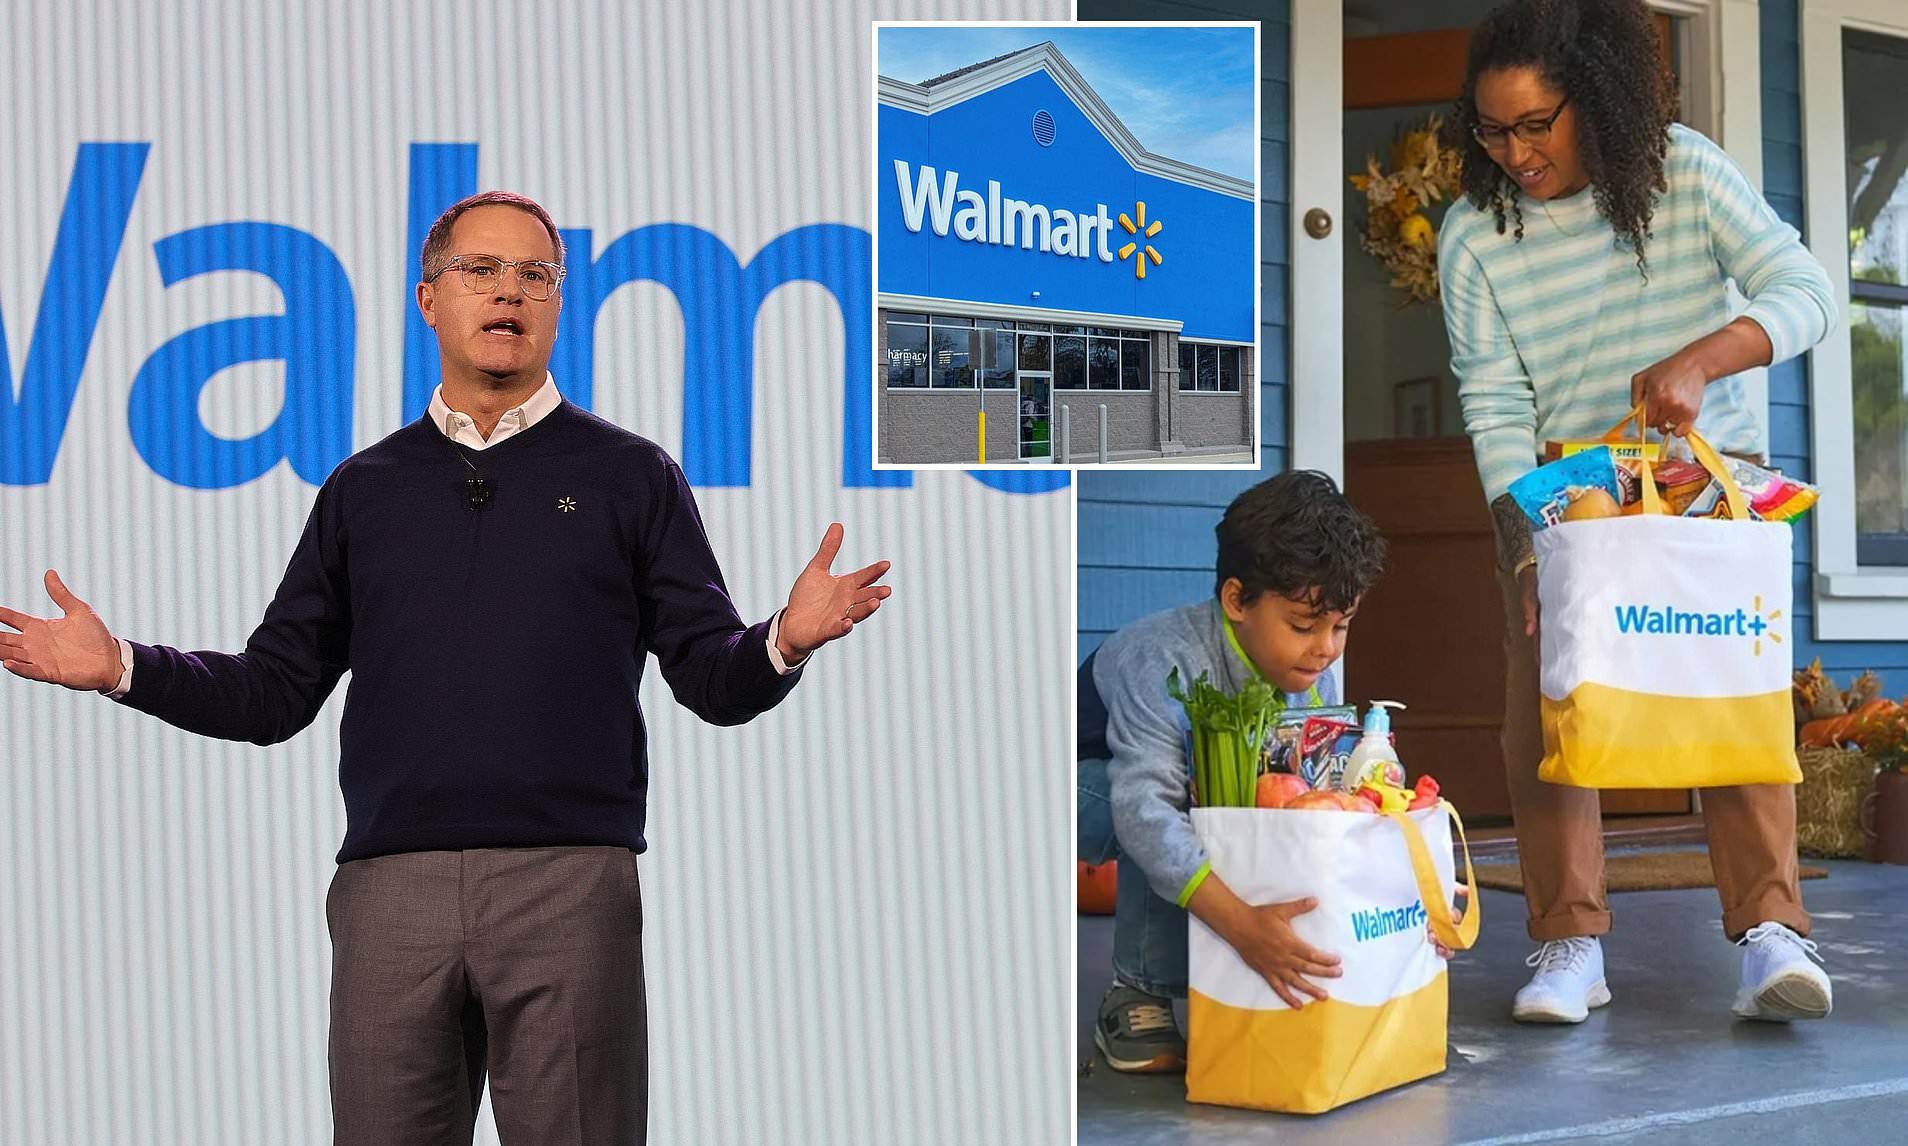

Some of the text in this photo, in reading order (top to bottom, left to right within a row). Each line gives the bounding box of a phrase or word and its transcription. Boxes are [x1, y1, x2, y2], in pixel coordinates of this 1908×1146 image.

[894, 159, 1114, 263] Walmart
[887, 348, 927, 362] harmacy
[1615, 605, 1767, 636] Walmart+
